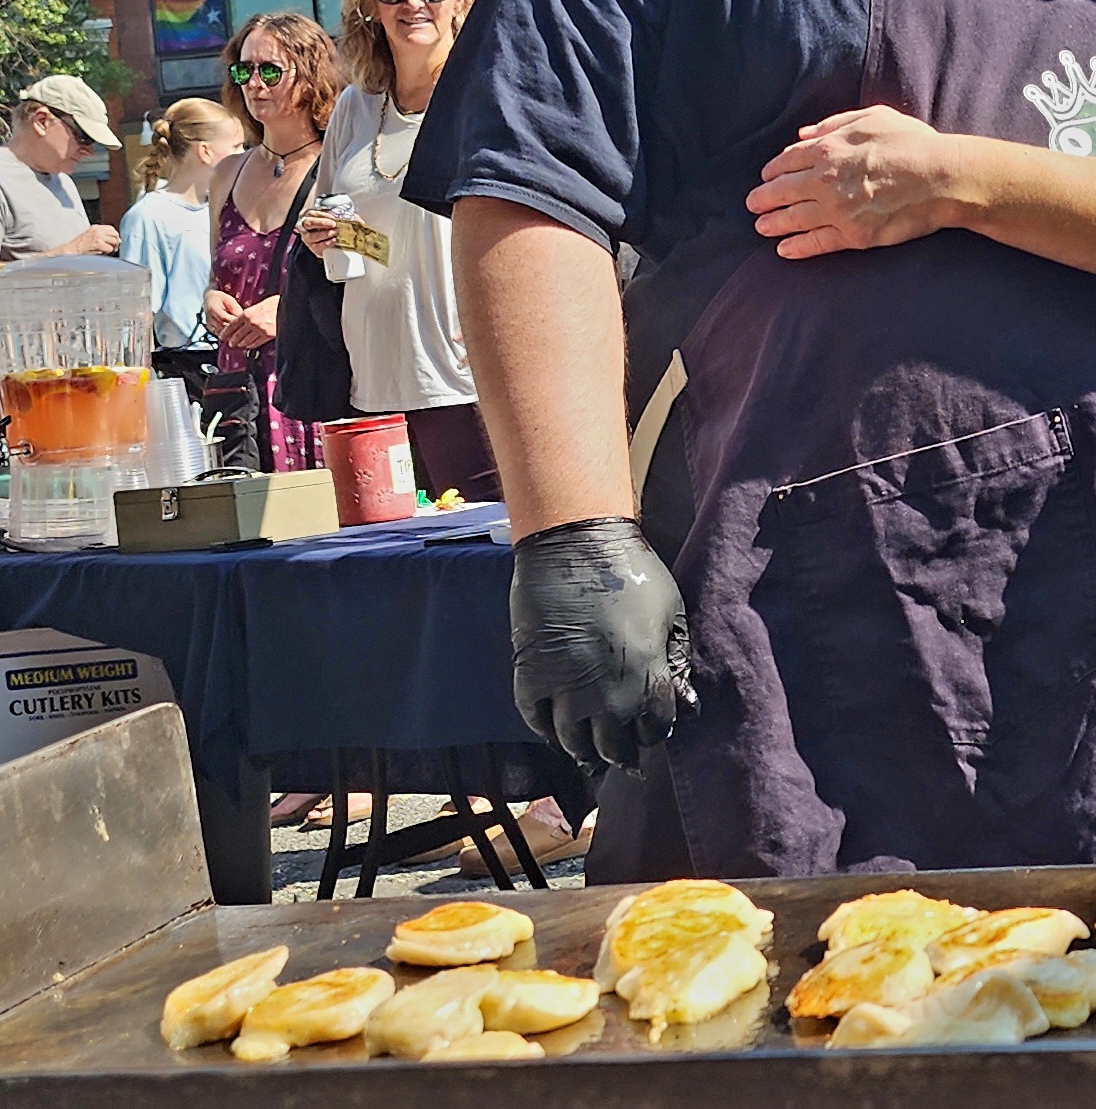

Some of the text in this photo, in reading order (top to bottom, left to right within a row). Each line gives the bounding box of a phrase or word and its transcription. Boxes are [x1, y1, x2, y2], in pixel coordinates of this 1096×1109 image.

[10, 662, 134, 686] MEDIUM WEIGHT
[9, 693, 95, 716] CUTLERY
[101, 687, 142, 707] KITS
